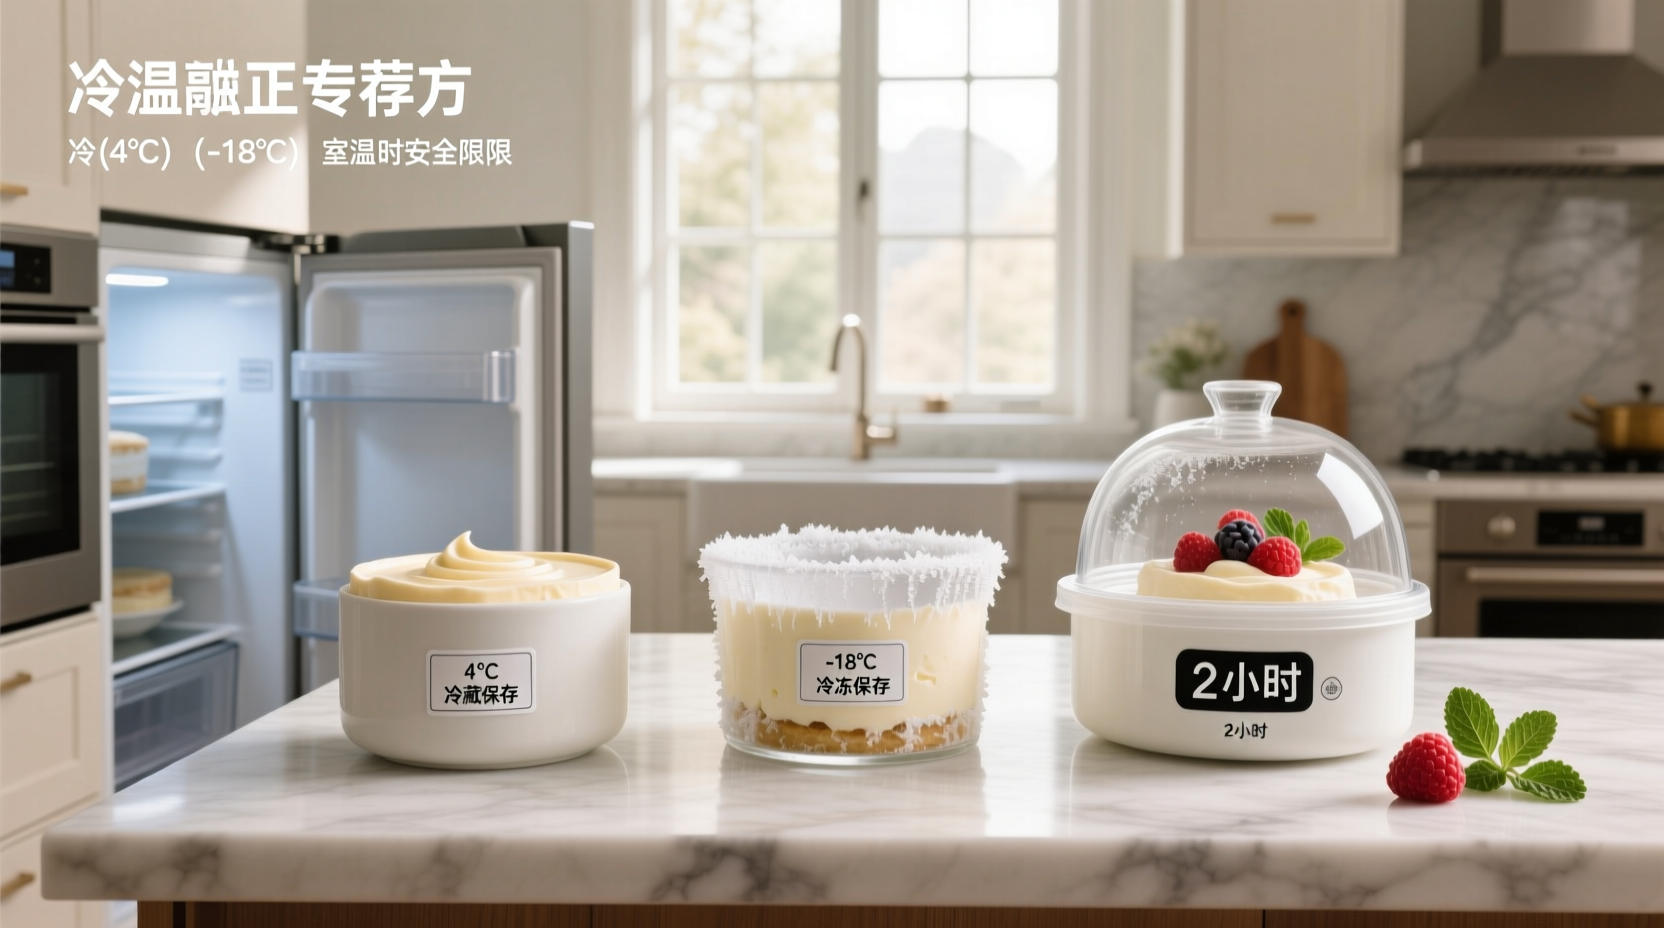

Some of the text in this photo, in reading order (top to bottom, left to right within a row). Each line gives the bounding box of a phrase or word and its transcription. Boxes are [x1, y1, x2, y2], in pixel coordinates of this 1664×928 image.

[816, 675, 891, 696] 冷冻保存
[1192, 661, 1302, 703] 2小时
[1224, 721, 1268, 740] 2小时
